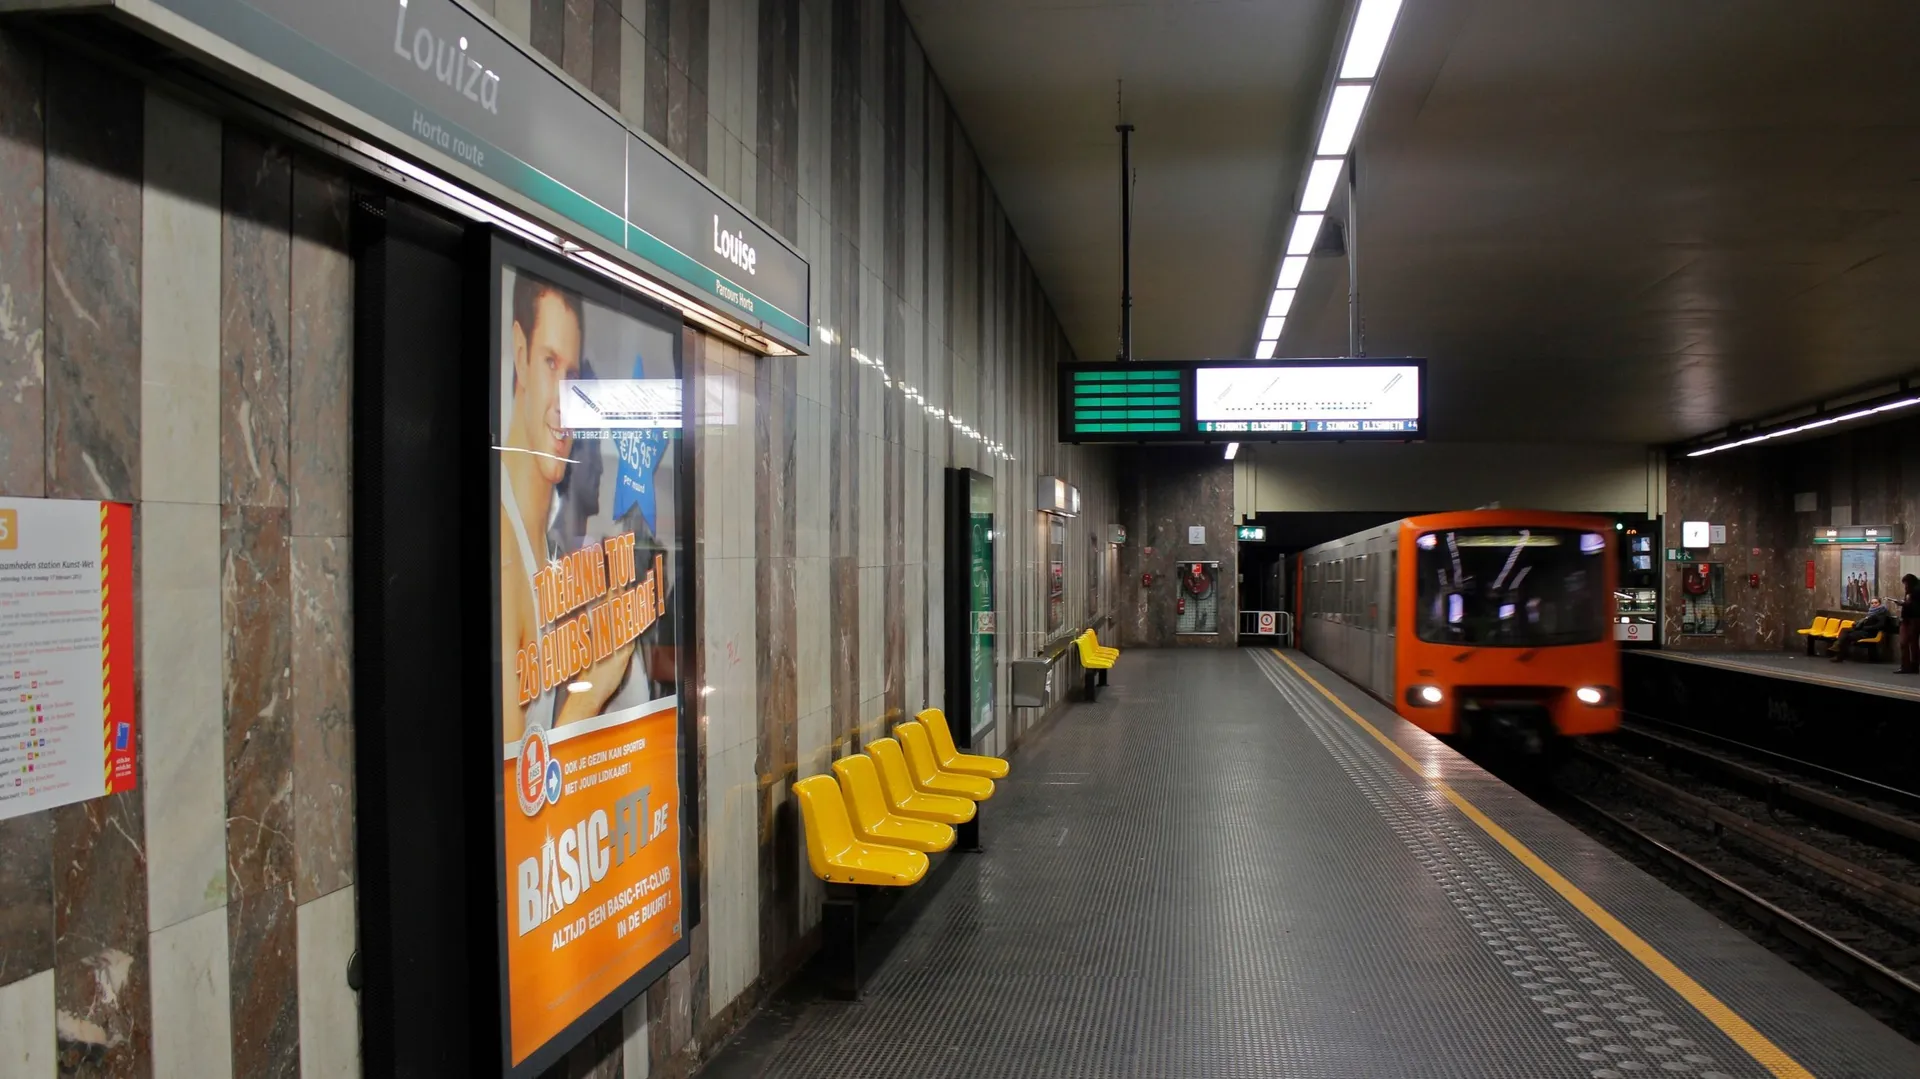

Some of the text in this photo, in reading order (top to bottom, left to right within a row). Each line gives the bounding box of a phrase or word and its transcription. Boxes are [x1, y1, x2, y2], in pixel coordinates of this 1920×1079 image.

[394, 0, 500, 115] Louiza
[412, 109, 485, 168] Horta route
[713, 214, 756, 275] Louise
[716, 279, 754, 312] Parcours Horta
[1317, 421, 1323, 431] 2
[38, 561, 60, 569] station
[62, 560, 94, 569] Kunst-Wet
[533, 532, 636, 629] TOEGANG TOT
[516, 642, 541, 706] 26
[541, 613, 592, 692] CLUBS
[591, 602, 613, 663] IN
[611, 570, 656, 651] BELGIË
[565, 760, 578, 775] OOK
[579, 757, 586, 770] JE
[608, 746, 622, 760] KAN
[622, 738, 646, 756] SPORTEN
[565, 780, 578, 796] MET
[579, 773, 598, 790] JOUW
[551, 865, 671, 952] ALTIJD EEN BASIC-FIT-CLUB
[617, 921, 627, 940] IN
[628, 913, 640, 932] DE
[641, 896, 668, 924] BUURT
